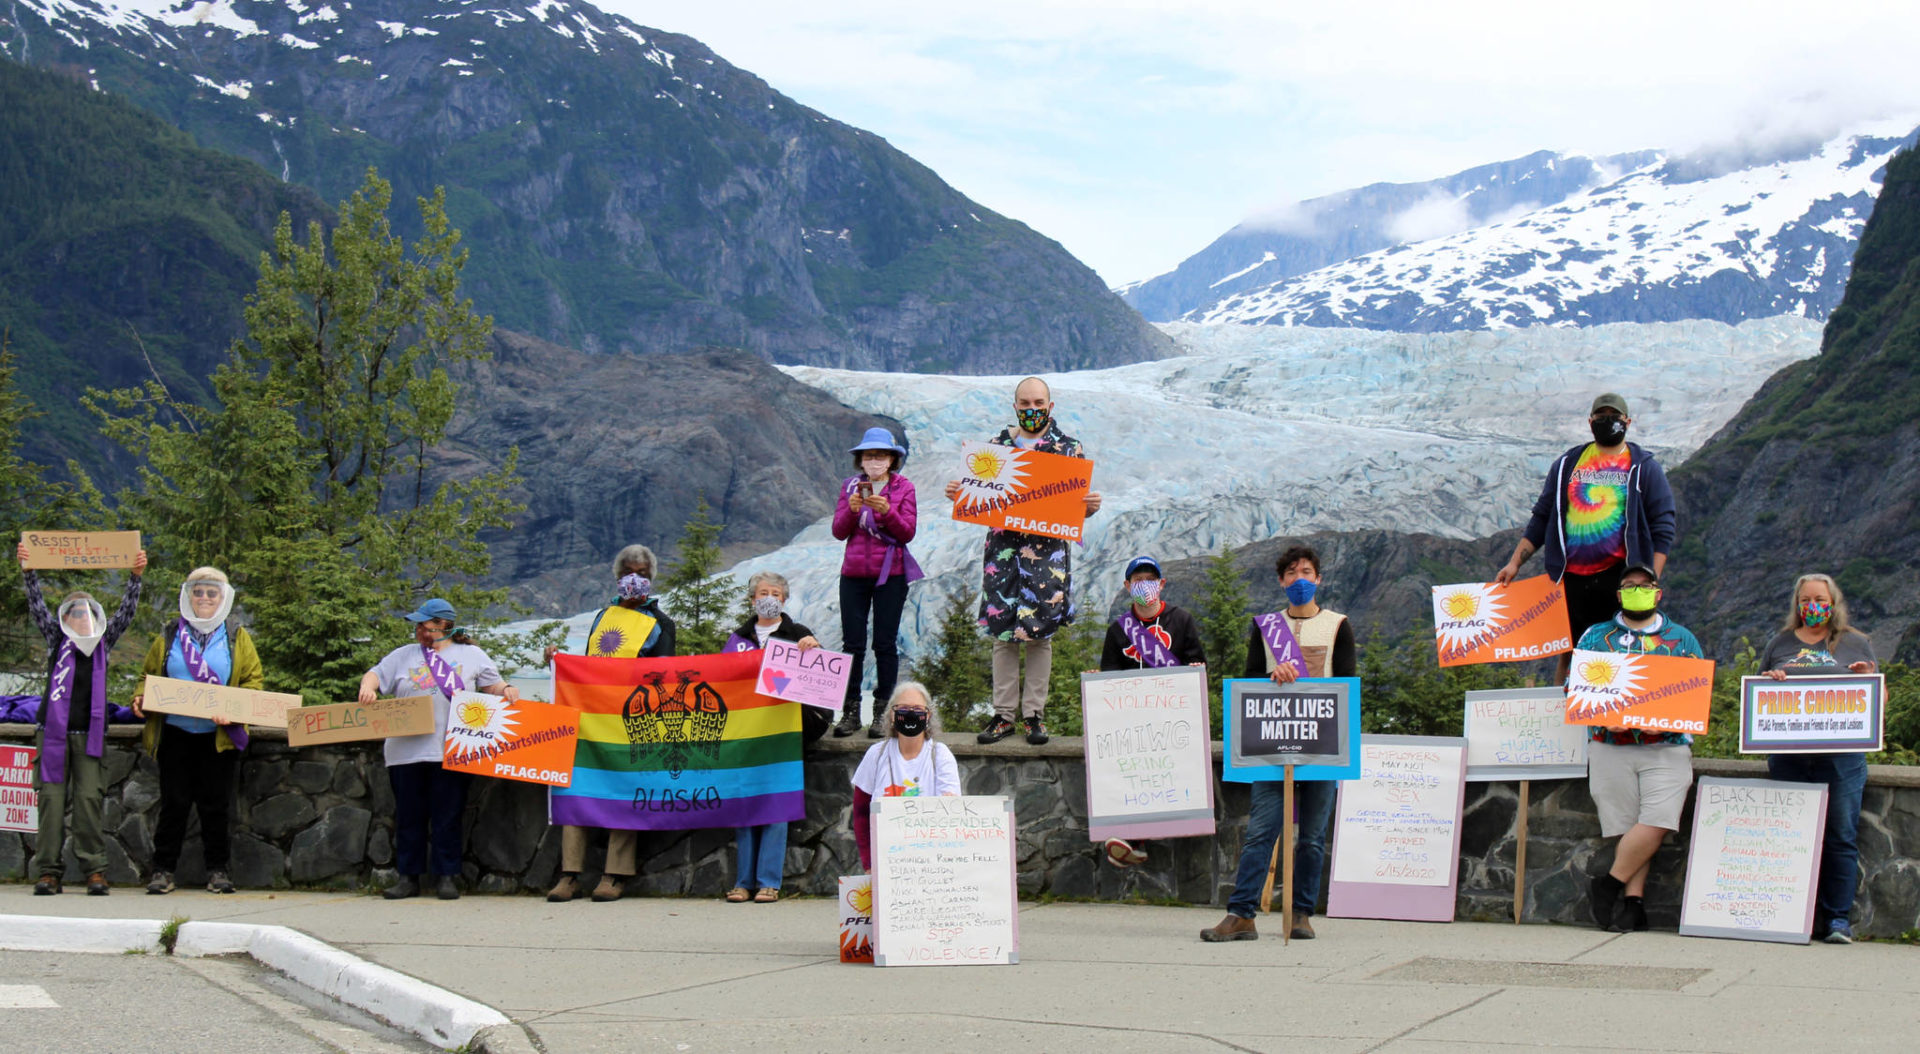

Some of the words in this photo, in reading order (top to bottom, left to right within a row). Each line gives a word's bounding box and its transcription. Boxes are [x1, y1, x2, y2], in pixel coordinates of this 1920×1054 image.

[961, 477, 1004, 491] PFLAG
[956, 477, 1087, 518] #EqualityStartsWithMe
[1004, 515, 1079, 538] PFLAG.ORG
[1441, 619, 1486, 630] PFLAG
[1442, 589, 1563, 663] #EqualityStartsWithMe
[1494, 637, 1570, 659] PFLAG.ORG
[771, 644, 842, 675] PFLAG
[1102, 678, 1143, 693] STOP
[1152, 677, 1175, 689] THE
[1573, 685, 1620, 695] PFLAG
[152, 684, 218, 709] LOVE
[1104, 694, 1191, 711] VIOLENCE
[1569, 676, 1709, 722] #EqualityStartsWithMe
[1757, 691, 1801, 715] PRIDE
[1804, 689, 1867, 714] CHORUS
[1245, 698, 1291, 718] BLACK
[1295, 698, 1335, 719] LIVES
[1474, 700, 1536, 717] HEALTH
[305, 708, 367, 733] PFLAG
[1498, 715, 1560, 729] RIGHTS
[1622, 715, 1704, 731] PFLAG.ORG
[451, 727, 494, 739] PFLAG
[1261, 720, 1318, 740] MATTER
[1518, 729, 1541, 739] ARE
[446, 725, 575, 767] #EqualityStartsWithMe
[1096, 720, 1191, 759] MMIWG
[1501, 740, 1561, 751] HUMAN
[14, 752, 29, 767] NO
[1366, 747, 1440, 762] EMPLOYERS
[1117, 755, 1174, 772] BRING
[1404, 761, 1424, 771] NOT
[494, 763, 569, 783] PFLAG.ORG
[1123, 772, 1173, 789] THEM
[0, 789, 39, 807] OADING
[632, 786, 722, 812] ALASKA
[1385, 787, 1420, 803] SEX
[1710, 786, 1755, 804] BLACK
[1763, 789, 1806, 806] LIVES
[6, 808, 28, 824] ZONE
[903, 800, 978, 816] BLACK
[889, 815, 1001, 829] TRANSGENDER
[904, 828, 948, 839] LIVES
[956, 828, 1006, 840] MATTER
[1378, 850, 1429, 862] SCOTUS
[1376, 863, 1437, 878] 6/15/2020
[1706, 892, 1734, 901] TAKE
[1738, 893, 1773, 902] ACTION
[1779, 894, 1792, 903] TO
[1700, 902, 1723, 911] END
[1728, 901, 1778, 911] SYSTEMIC
[845, 916, 873, 926] PFL
[1730, 910, 1776, 919] RACISM
[927, 928, 964, 941] STOP
